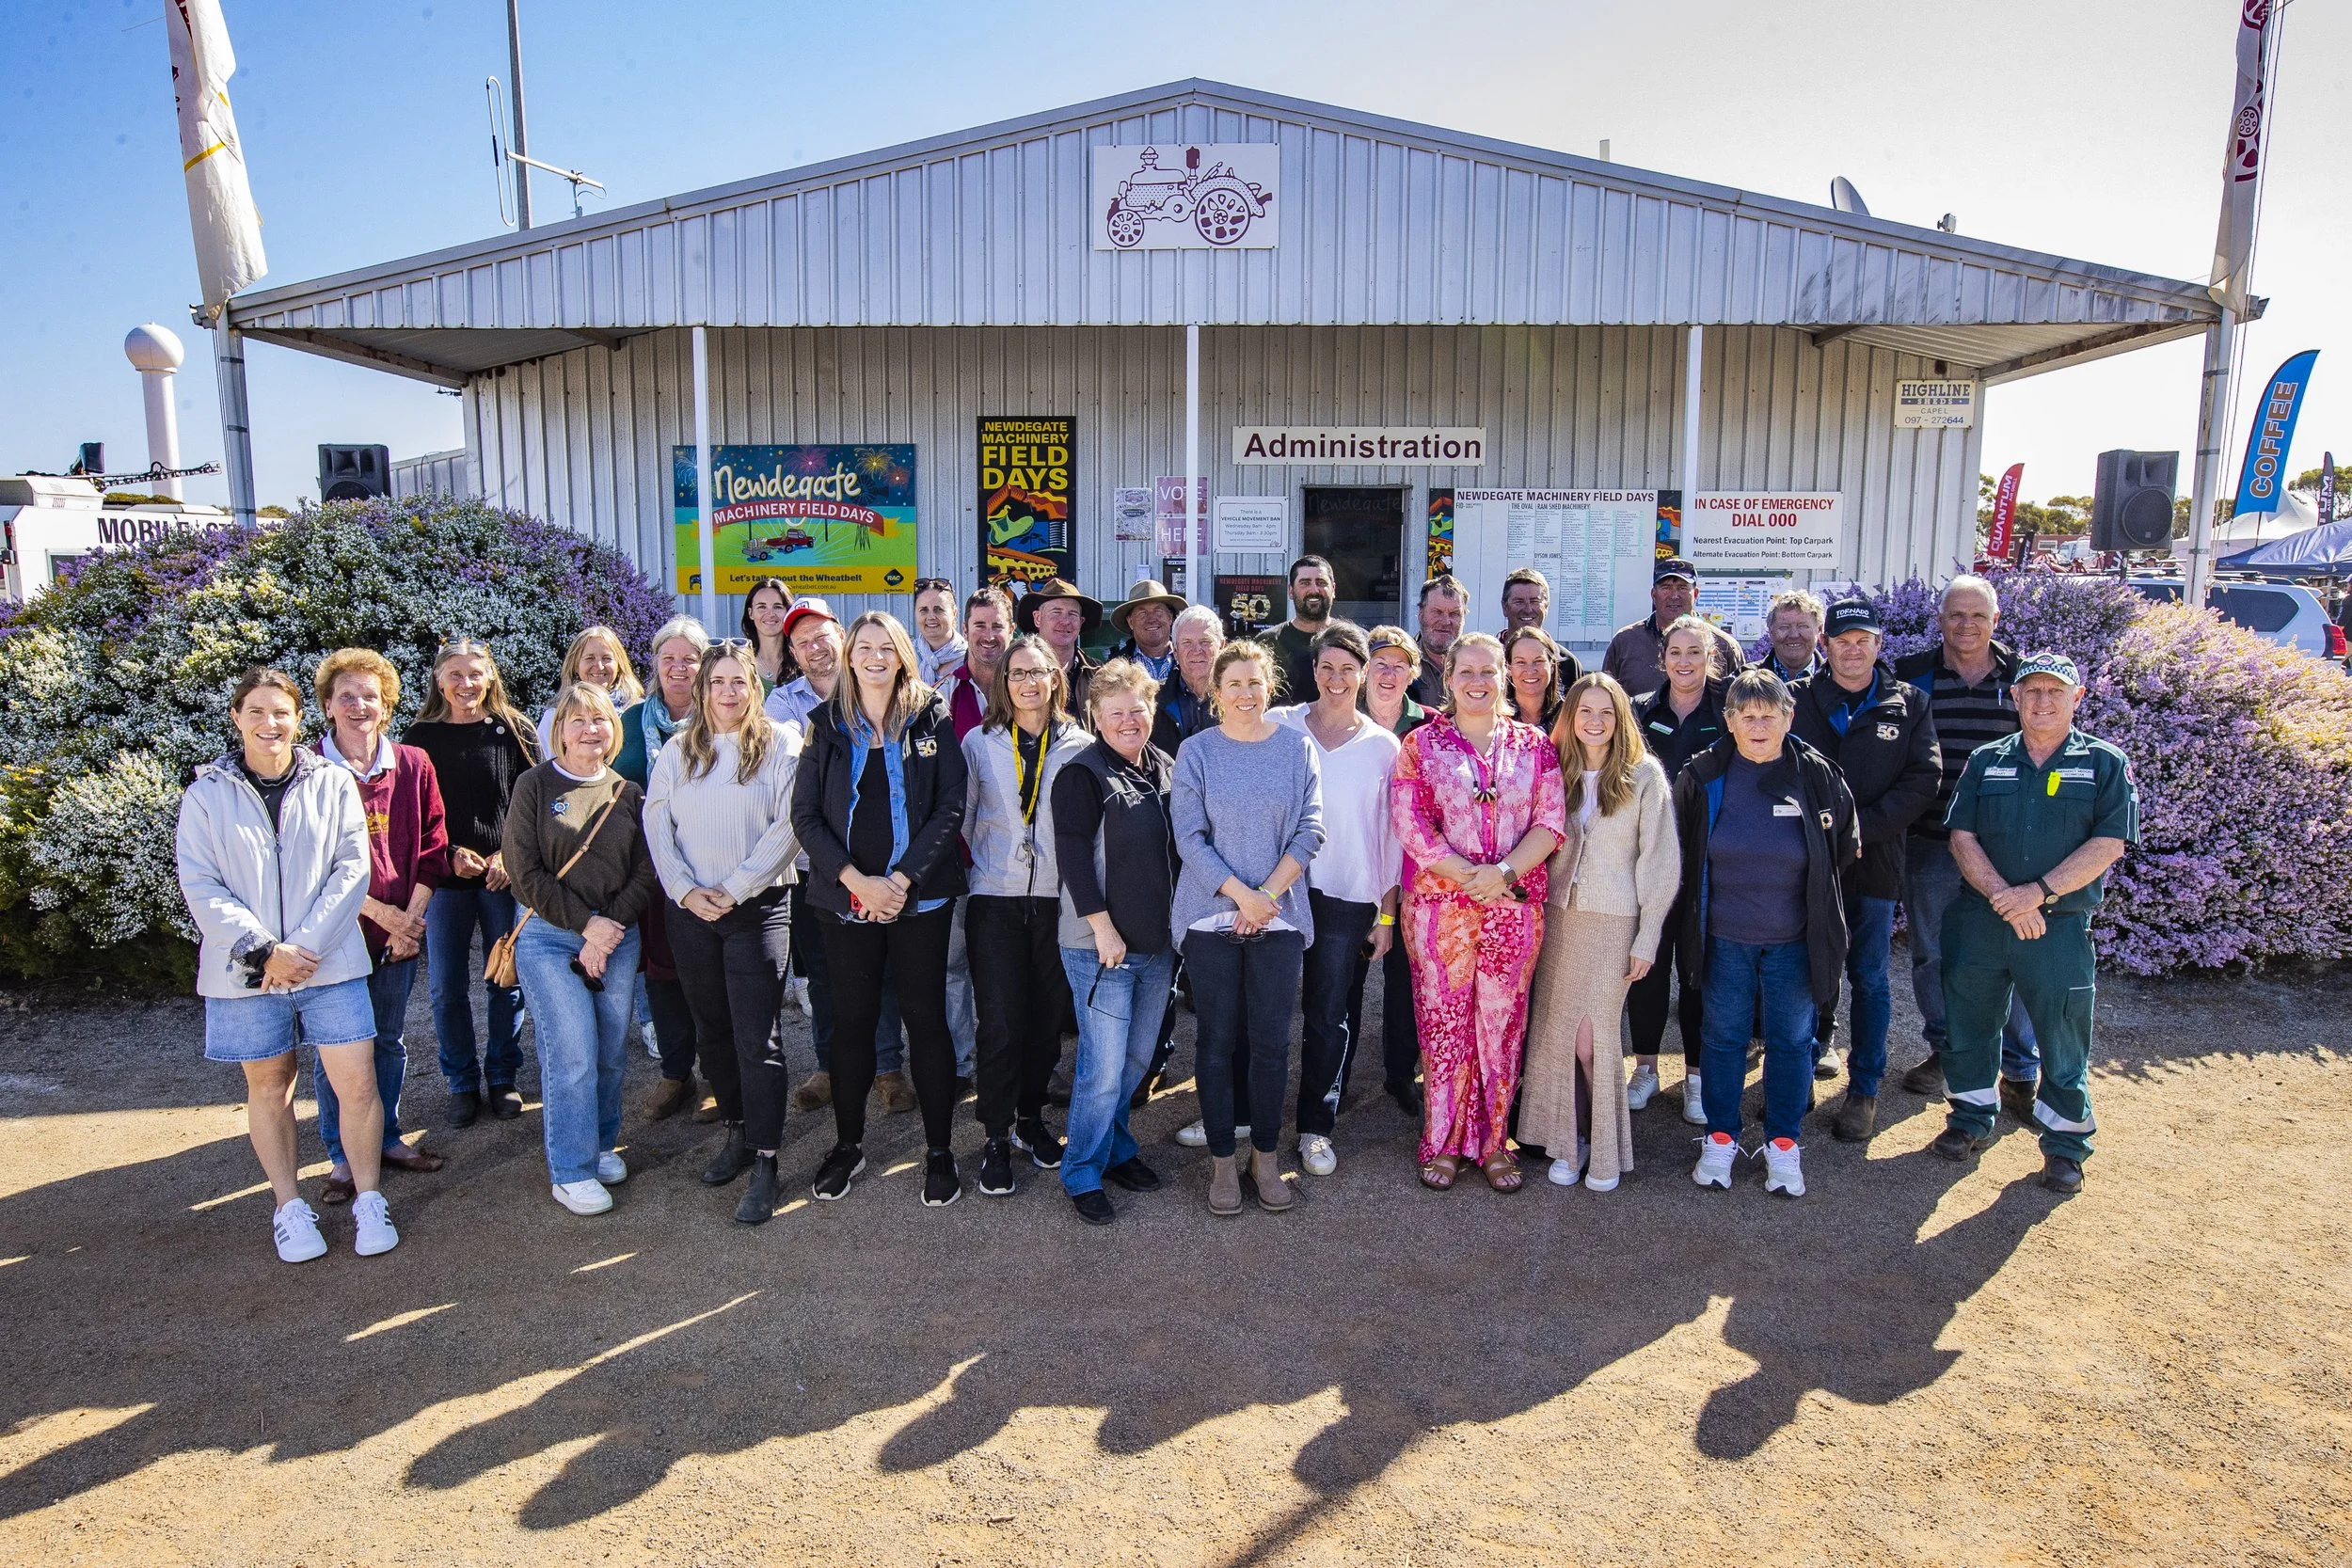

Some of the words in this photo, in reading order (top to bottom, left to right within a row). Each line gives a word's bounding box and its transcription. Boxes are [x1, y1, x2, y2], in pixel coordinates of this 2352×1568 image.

[1901, 384, 1970, 397] HIGHLINE
[984, 421, 1068, 432] NEWDEGATE
[981, 434, 1069, 444] MACHINERY
[1244, 433, 1482, 459] Administration
[2249, 382, 2298, 499] COFFEE
[983, 446, 1068, 466] FIELD
[983, 467, 1068, 490] DAYS
[1160, 485, 1202, 500] VOE
[1457, 491, 1523, 500] NEWDEGATE
[1527, 491, 1590, 501] MACHINERY
[1593, 491, 1622, 501] FIELD
[1627, 492, 1655, 502] DAYS
[1694, 499, 1707, 510] IN
[1709, 499, 1740, 510] CASE
[1743, 499, 1759, 510] OF
[1761, 499, 1835, 510] EMERGENCY
[713, 502, 795, 524] MACHINERY
[800, 502, 837, 517] FIELD
[839, 506, 875, 524] DAYS
[1991, 474, 2013, 552] QUANTUM
[1732, 514, 1765, 527] DIAL
[1769, 514, 1797, 527] 000
[1161, 528, 1202, 542] HEE
[1693, 536, 1722, 545] Nearest
[1724, 536, 1764, 545] Evacuation
[1766, 536, 1788, 545] Point:
[1789, 537, 1803, 546] Top
[1804, 537, 1834, 546] Carpark
[1807, 551, 1833, 560] Carpark
[1230, 594, 1271, 620] 50
[1836, 608, 1869, 616] TORNADO
[1876, 724, 1899, 740] 50
[915, 740, 937, 757] 50
